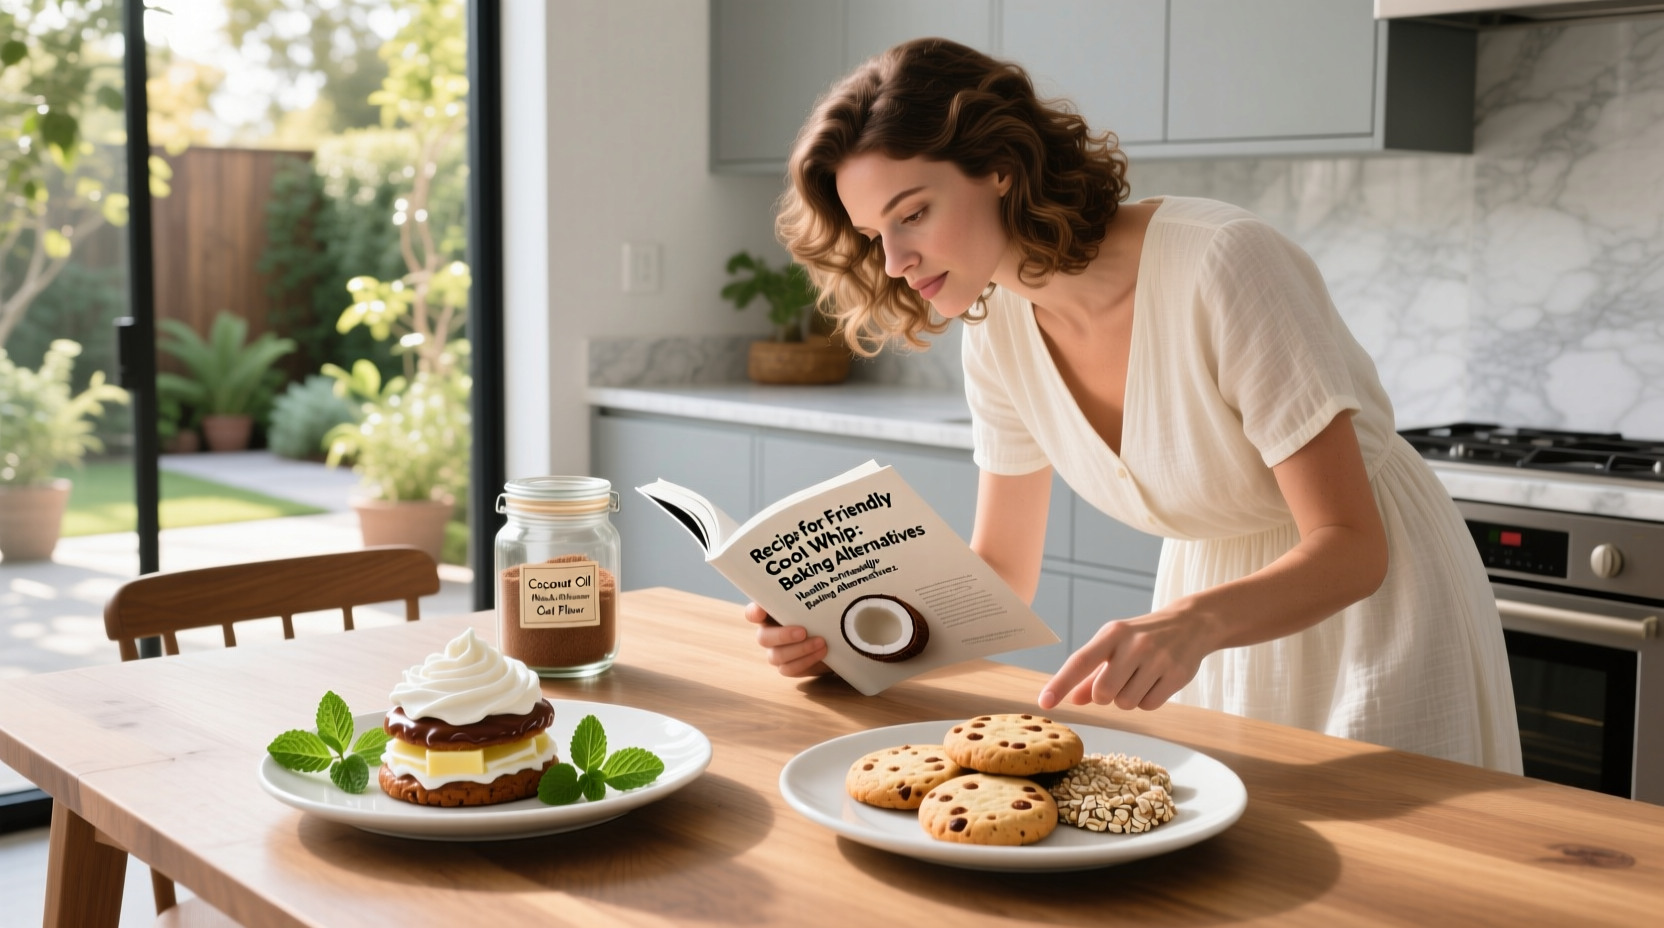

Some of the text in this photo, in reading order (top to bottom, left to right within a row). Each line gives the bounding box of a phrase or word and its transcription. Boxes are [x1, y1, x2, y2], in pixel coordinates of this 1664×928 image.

[798, 518, 824, 537] for
[824, 492, 892, 525] Friendly
[766, 546, 809, 575] Cool
[807, 525, 863, 553] Whip:
[778, 558, 835, 591] Baking
[835, 525, 926, 565] Alternatives
[575, 575, 591, 587] Oil
